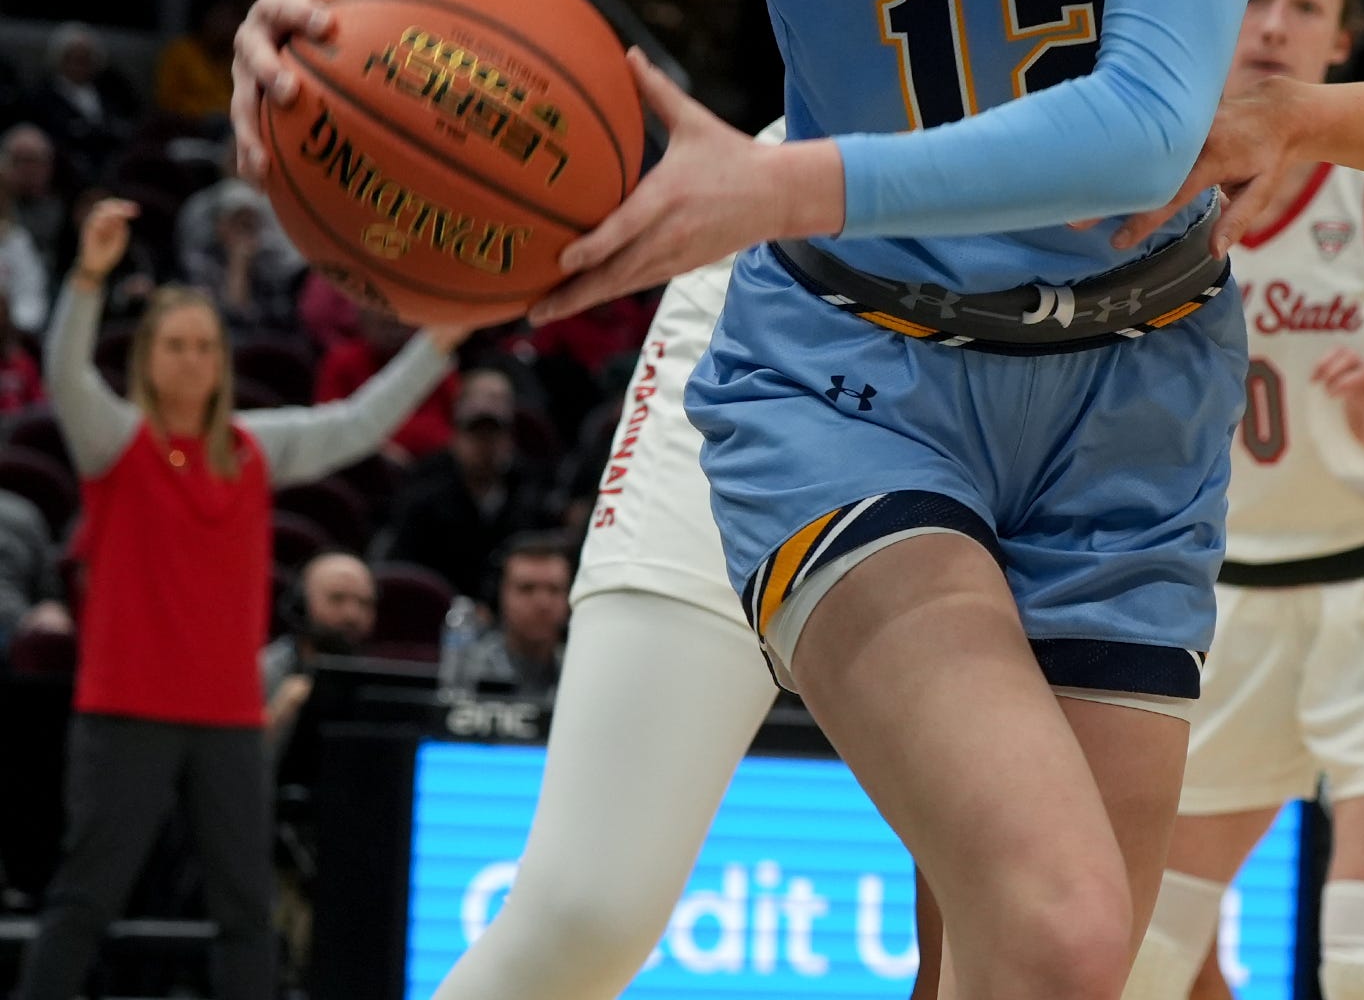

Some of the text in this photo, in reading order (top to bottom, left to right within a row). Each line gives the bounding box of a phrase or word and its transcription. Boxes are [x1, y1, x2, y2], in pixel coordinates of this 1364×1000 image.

[363, 41, 570, 187] LEGACY
[300, 98, 534, 275] SPALDING
[1255, 281, 1363, 335] State
[460, 860, 829, 976] Cdit
